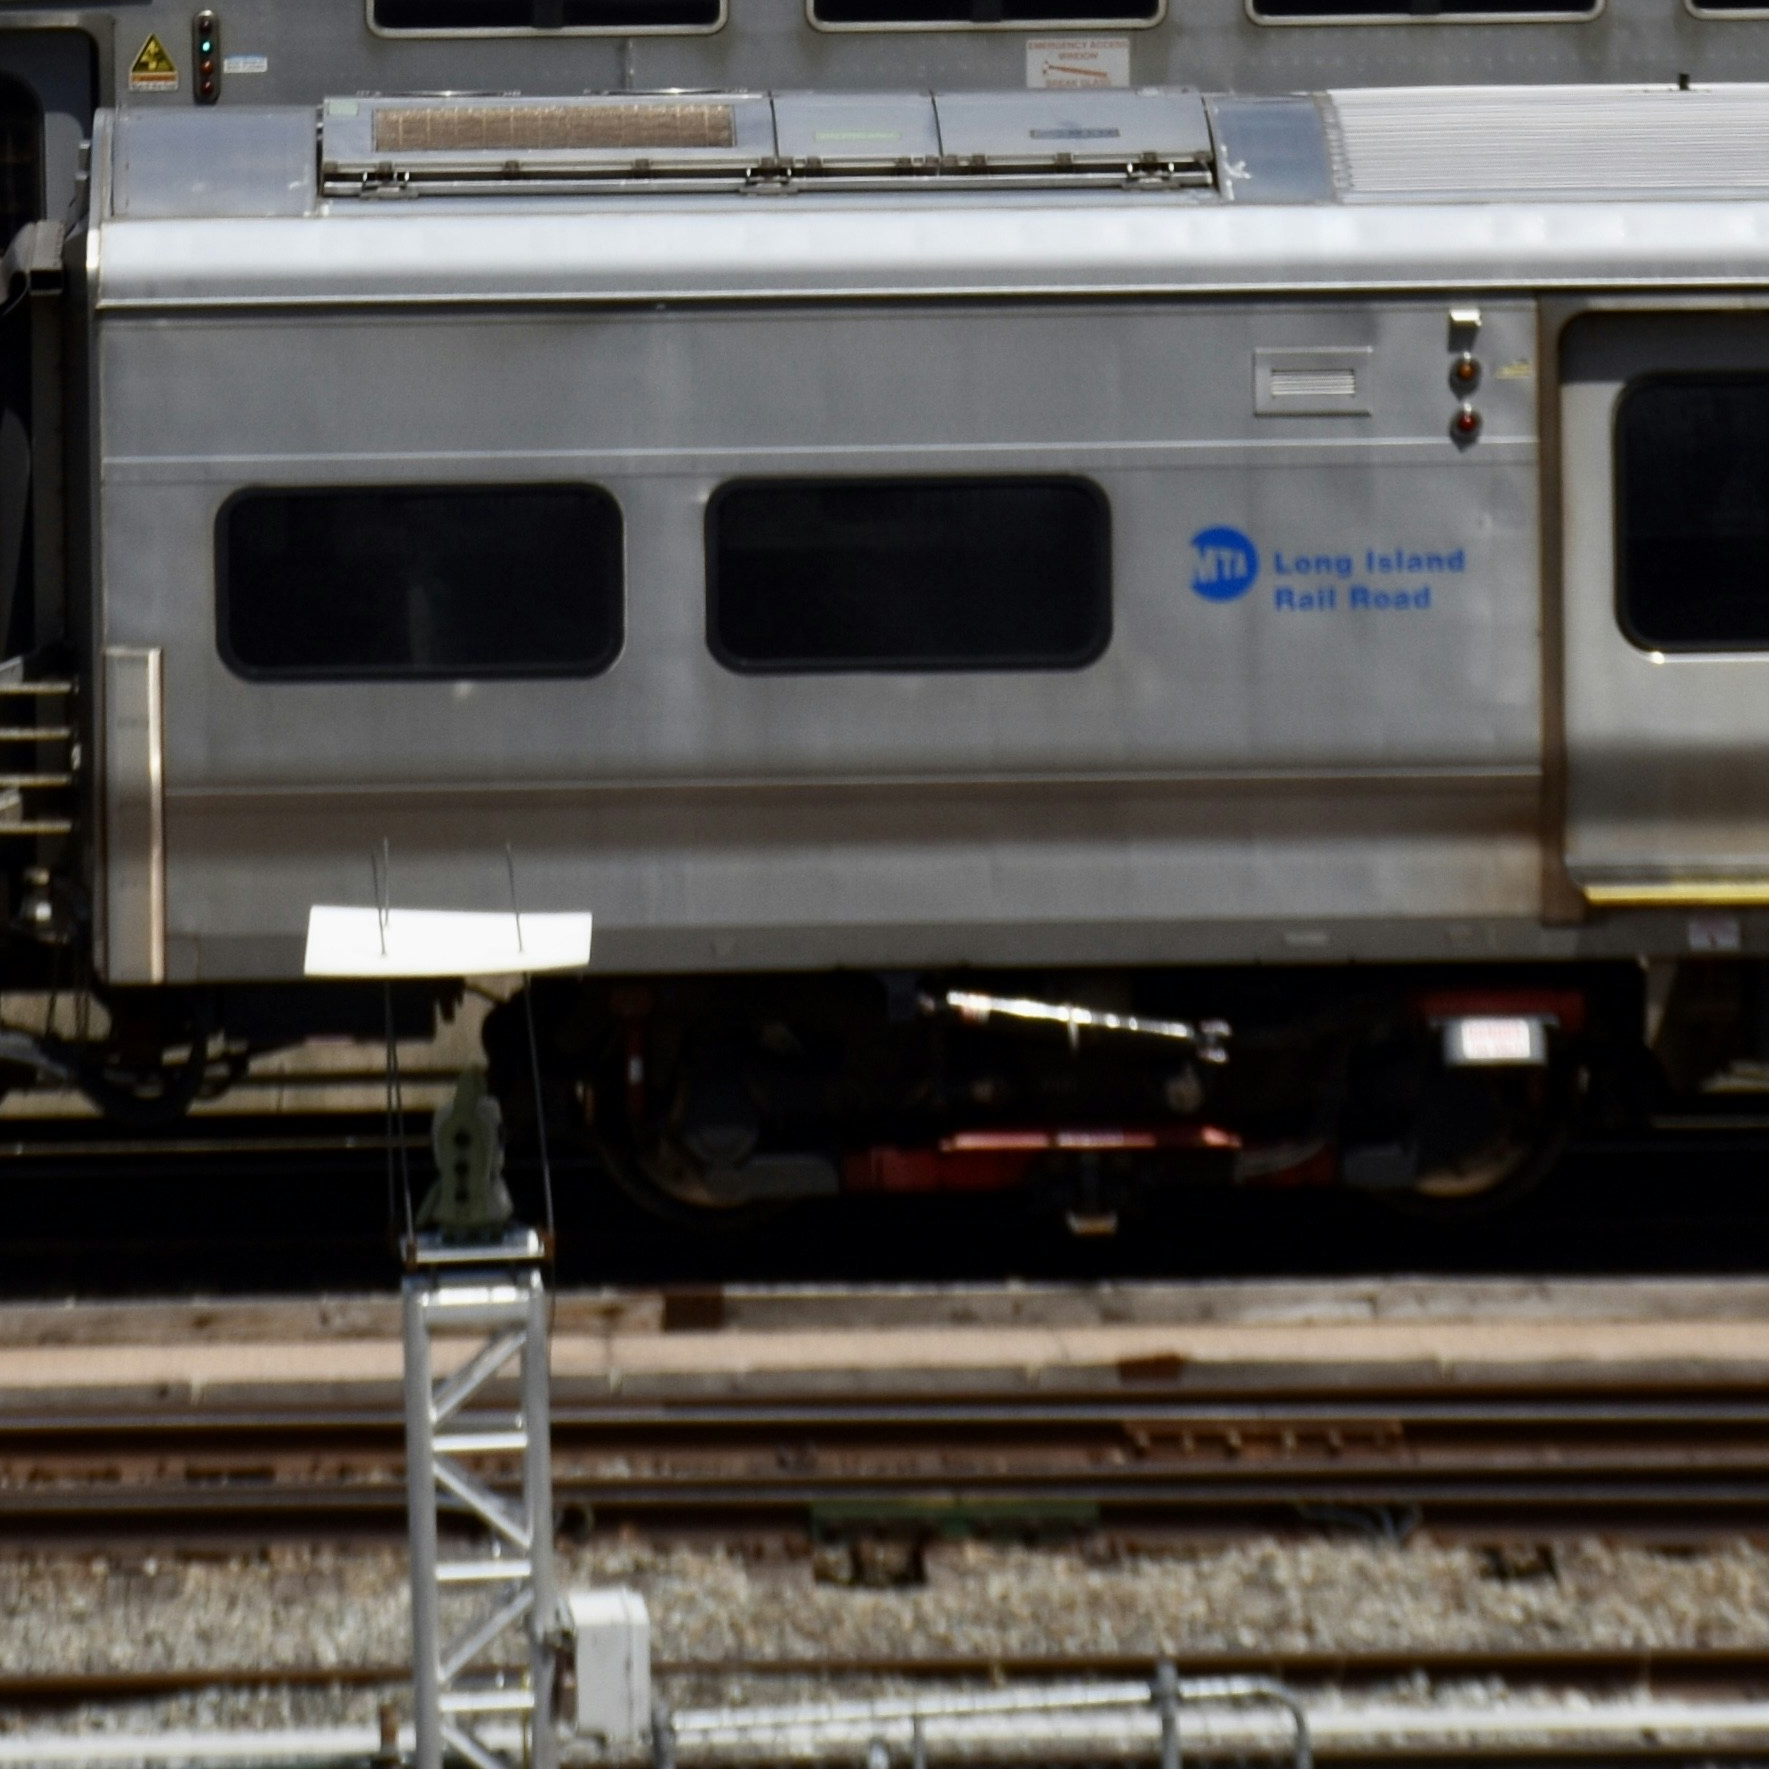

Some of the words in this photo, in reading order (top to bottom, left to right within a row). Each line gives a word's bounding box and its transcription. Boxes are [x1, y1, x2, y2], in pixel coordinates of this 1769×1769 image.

[1275, 551, 1353, 578] Long
[1367, 549, 1465, 574] Island
[1275, 587, 1337, 611] Rail
[1350, 586, 1431, 610] Road
